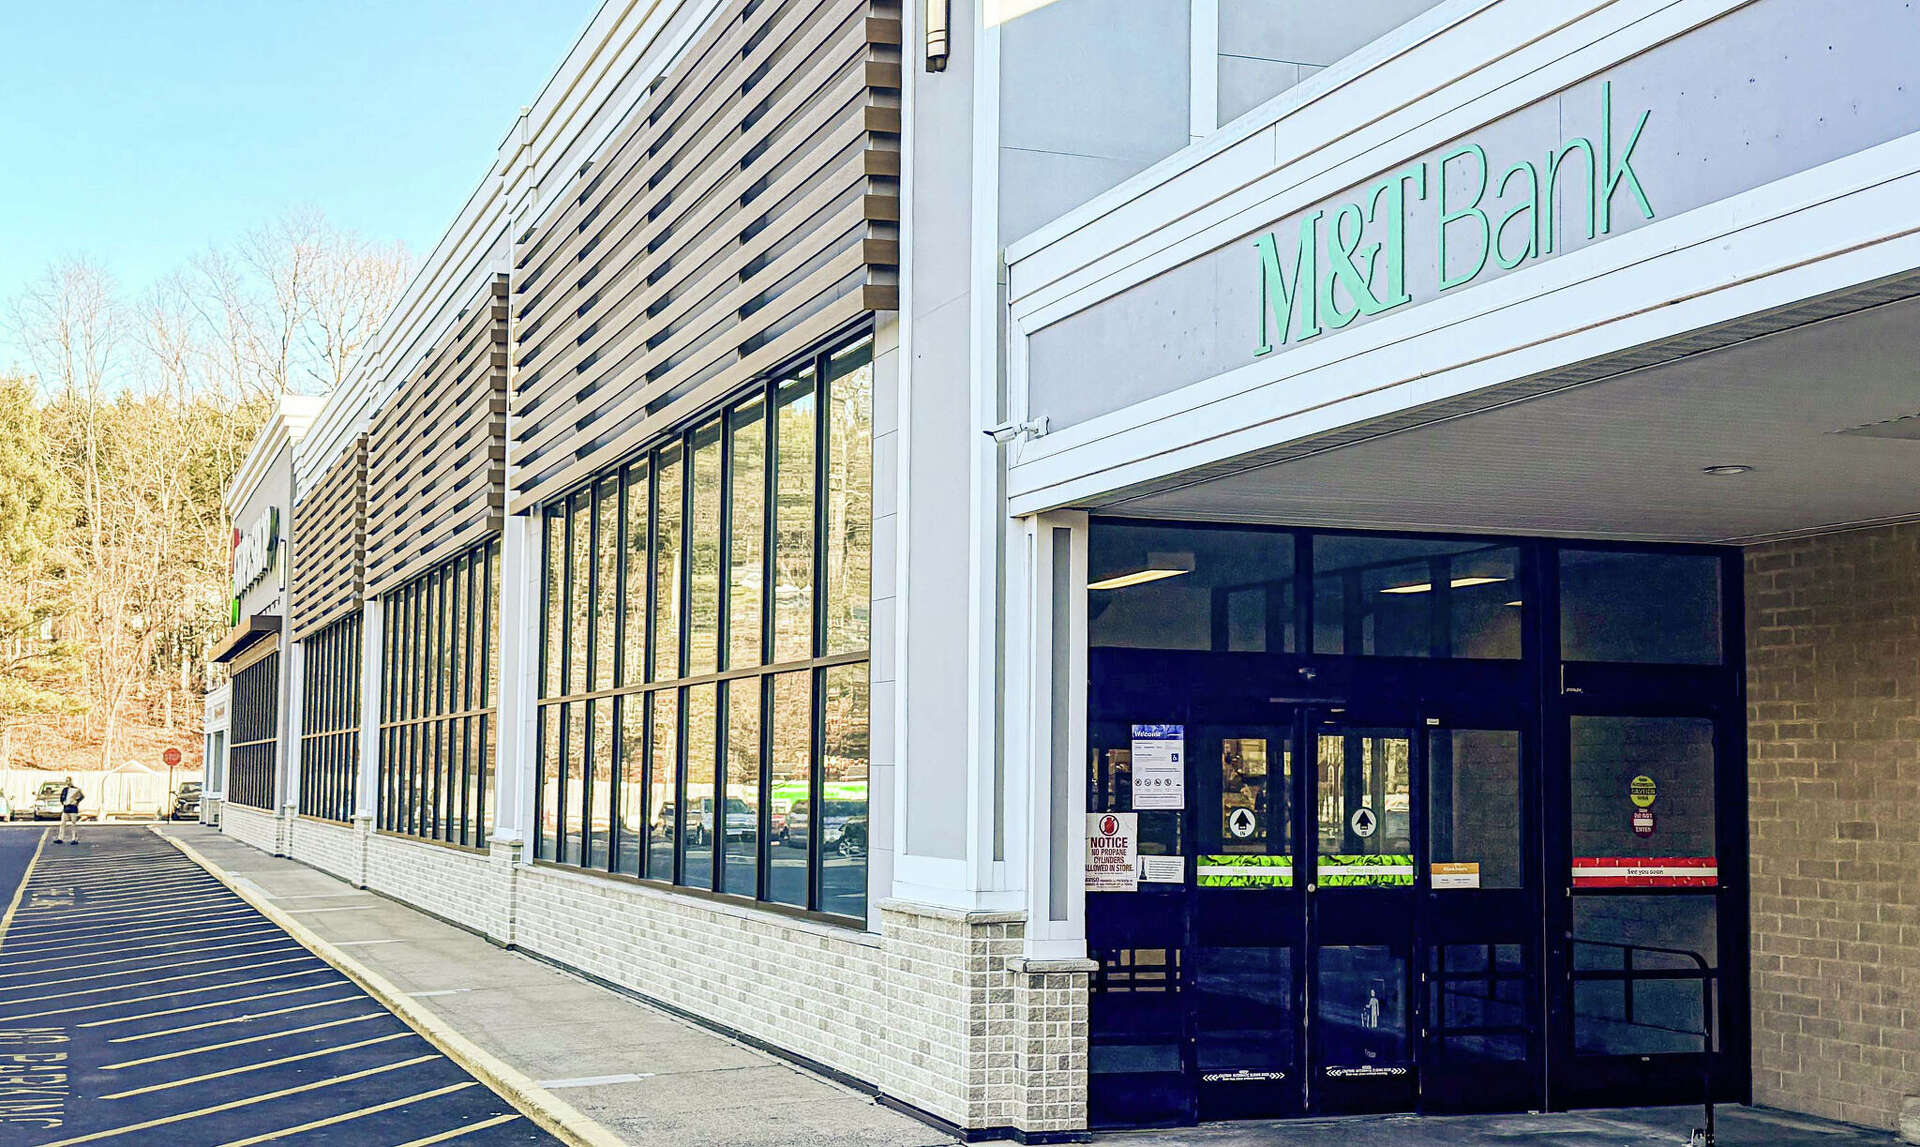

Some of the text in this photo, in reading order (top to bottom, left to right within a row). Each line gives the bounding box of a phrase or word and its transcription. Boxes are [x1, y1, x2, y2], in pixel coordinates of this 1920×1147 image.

[1253, 81, 1655, 357] M&T Bank
[1090, 837, 1128, 848] NOTICE
[1091, 848, 1127, 856] NO PROPANE
[1093, 856, 1125, 864] CYLINDERS
